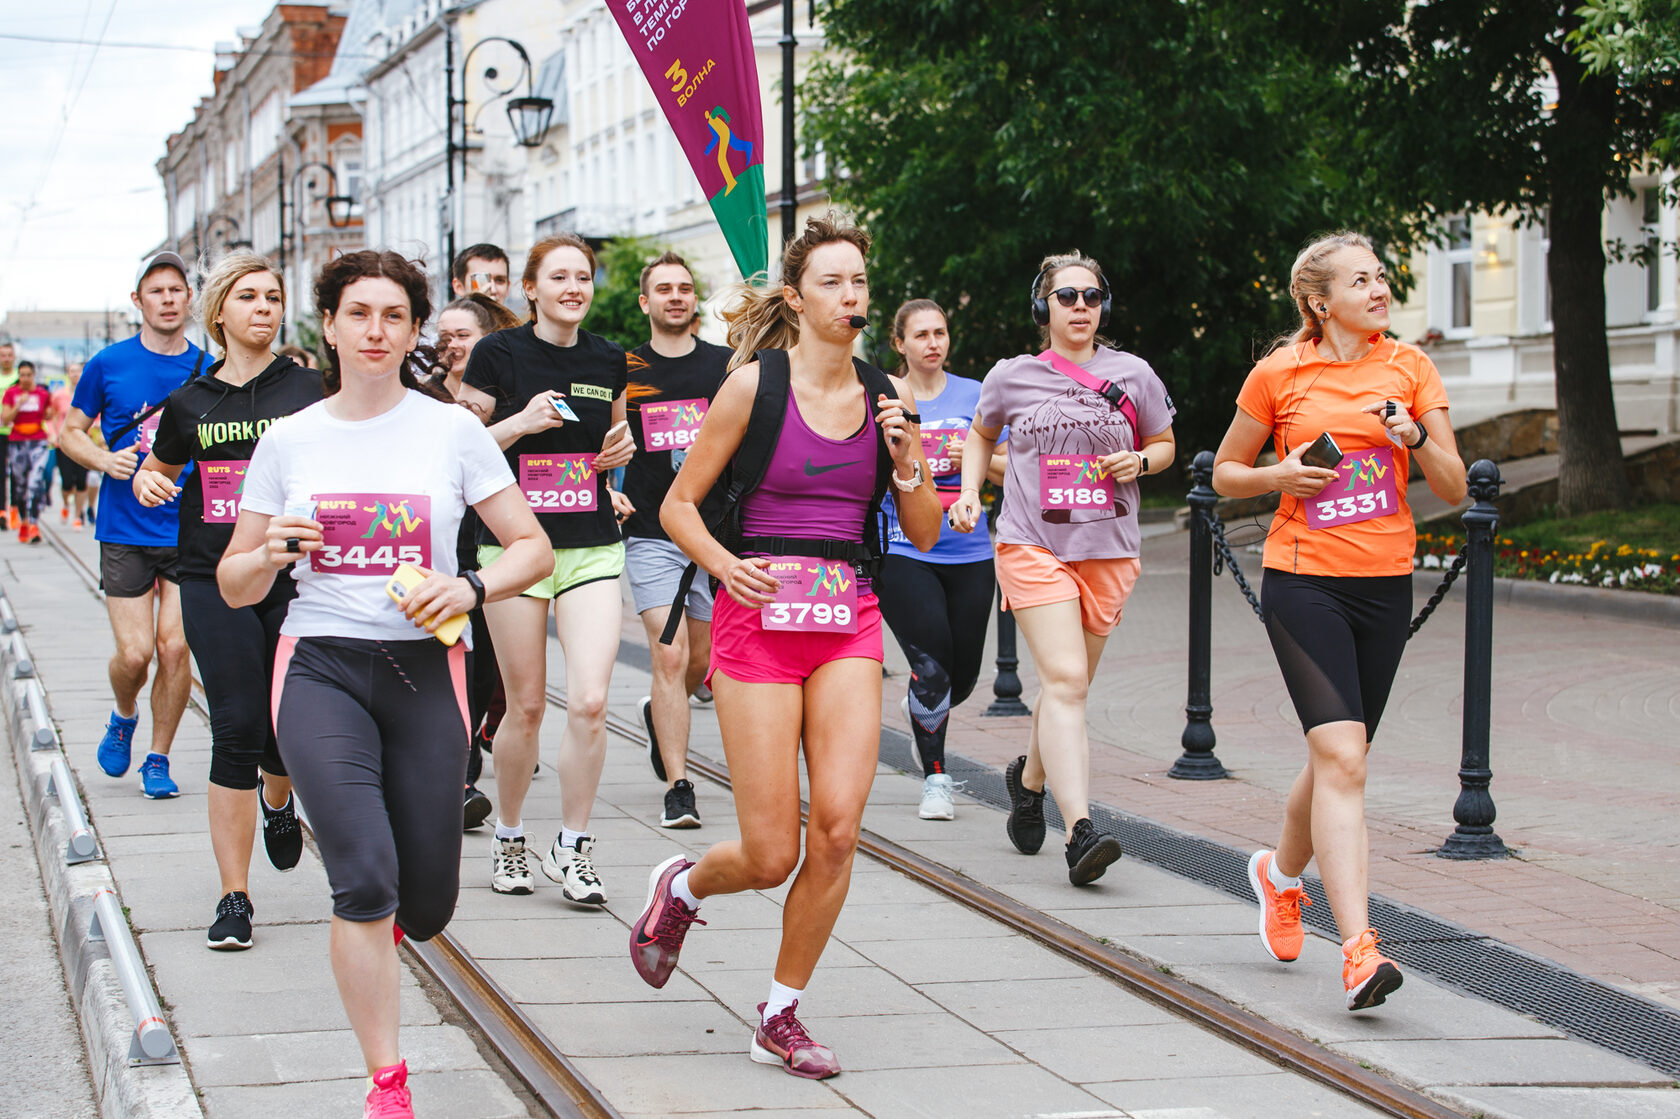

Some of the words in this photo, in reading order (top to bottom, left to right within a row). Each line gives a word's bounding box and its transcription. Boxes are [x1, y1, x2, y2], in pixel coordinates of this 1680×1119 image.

[633, 11, 643, 26] В
[647, 27, 665, 51] ПО
[664, 58, 688, 93] 3
[676, 58, 716, 108] ВОЛНА
[573, 386, 584, 394] WE
[586, 388, 599, 396] CAN
[197, 416, 284, 450] WORKO
[211, 499, 241, 517] 31
[526, 489, 593, 508] 3209
[1047, 488, 1107, 505] 3186
[1316, 489, 1388, 521] 3331
[318, 545, 424, 569] 3445
[769, 562, 802, 571] RUTS
[768, 602, 851, 626] 3799
